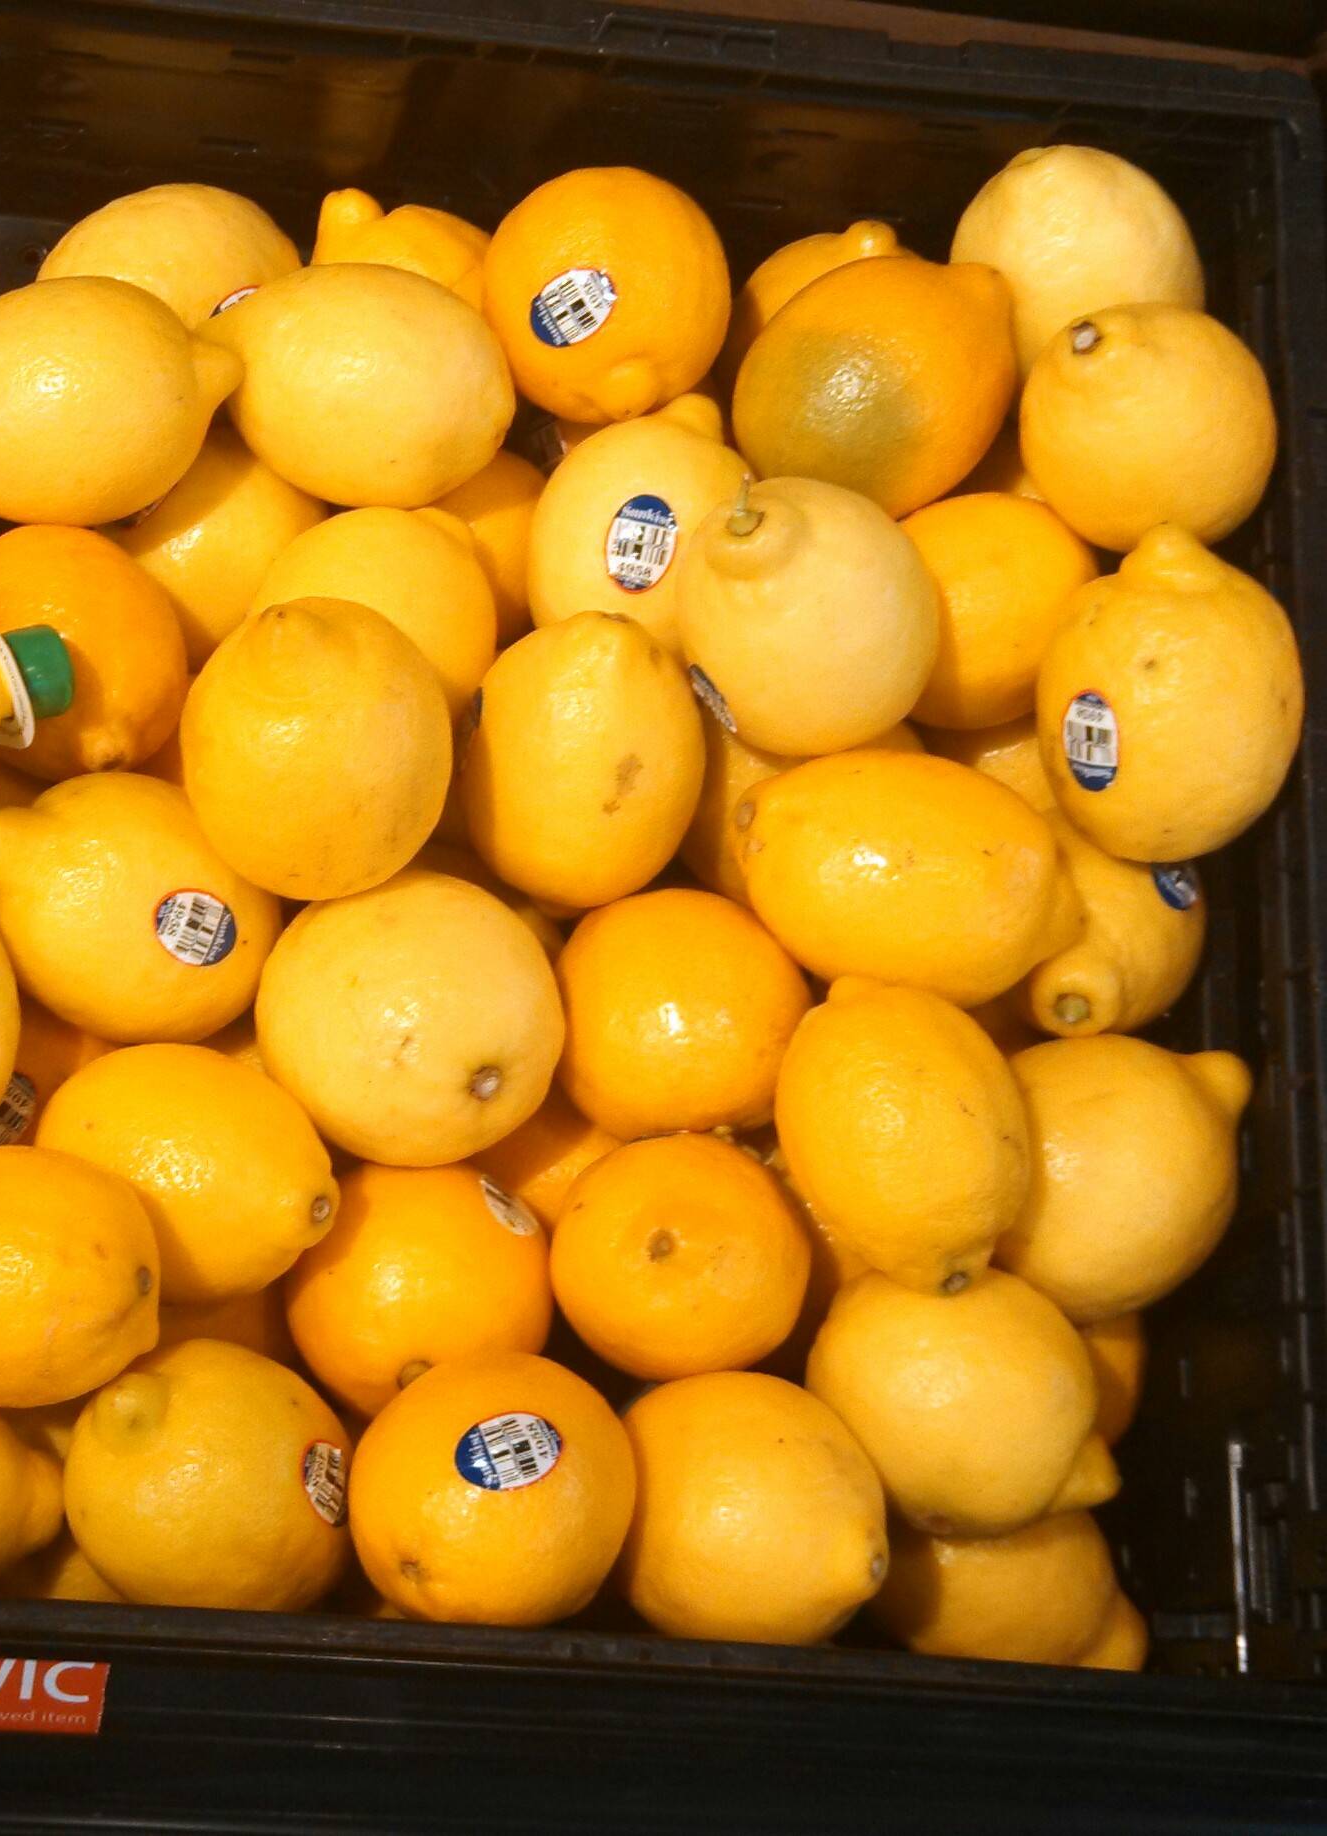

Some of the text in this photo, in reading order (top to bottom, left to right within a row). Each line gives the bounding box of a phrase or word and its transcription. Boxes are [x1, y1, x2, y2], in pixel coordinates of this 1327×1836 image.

[533, 301, 565, 347] Sunkist
[622, 504, 664, 526] Sunkist
[204, 911, 233, 964] Sunkist
[467, 1429, 499, 1487] Sunkist
[527, 1421, 549, 1460] 4958
[41, 1712, 87, 1726] item
